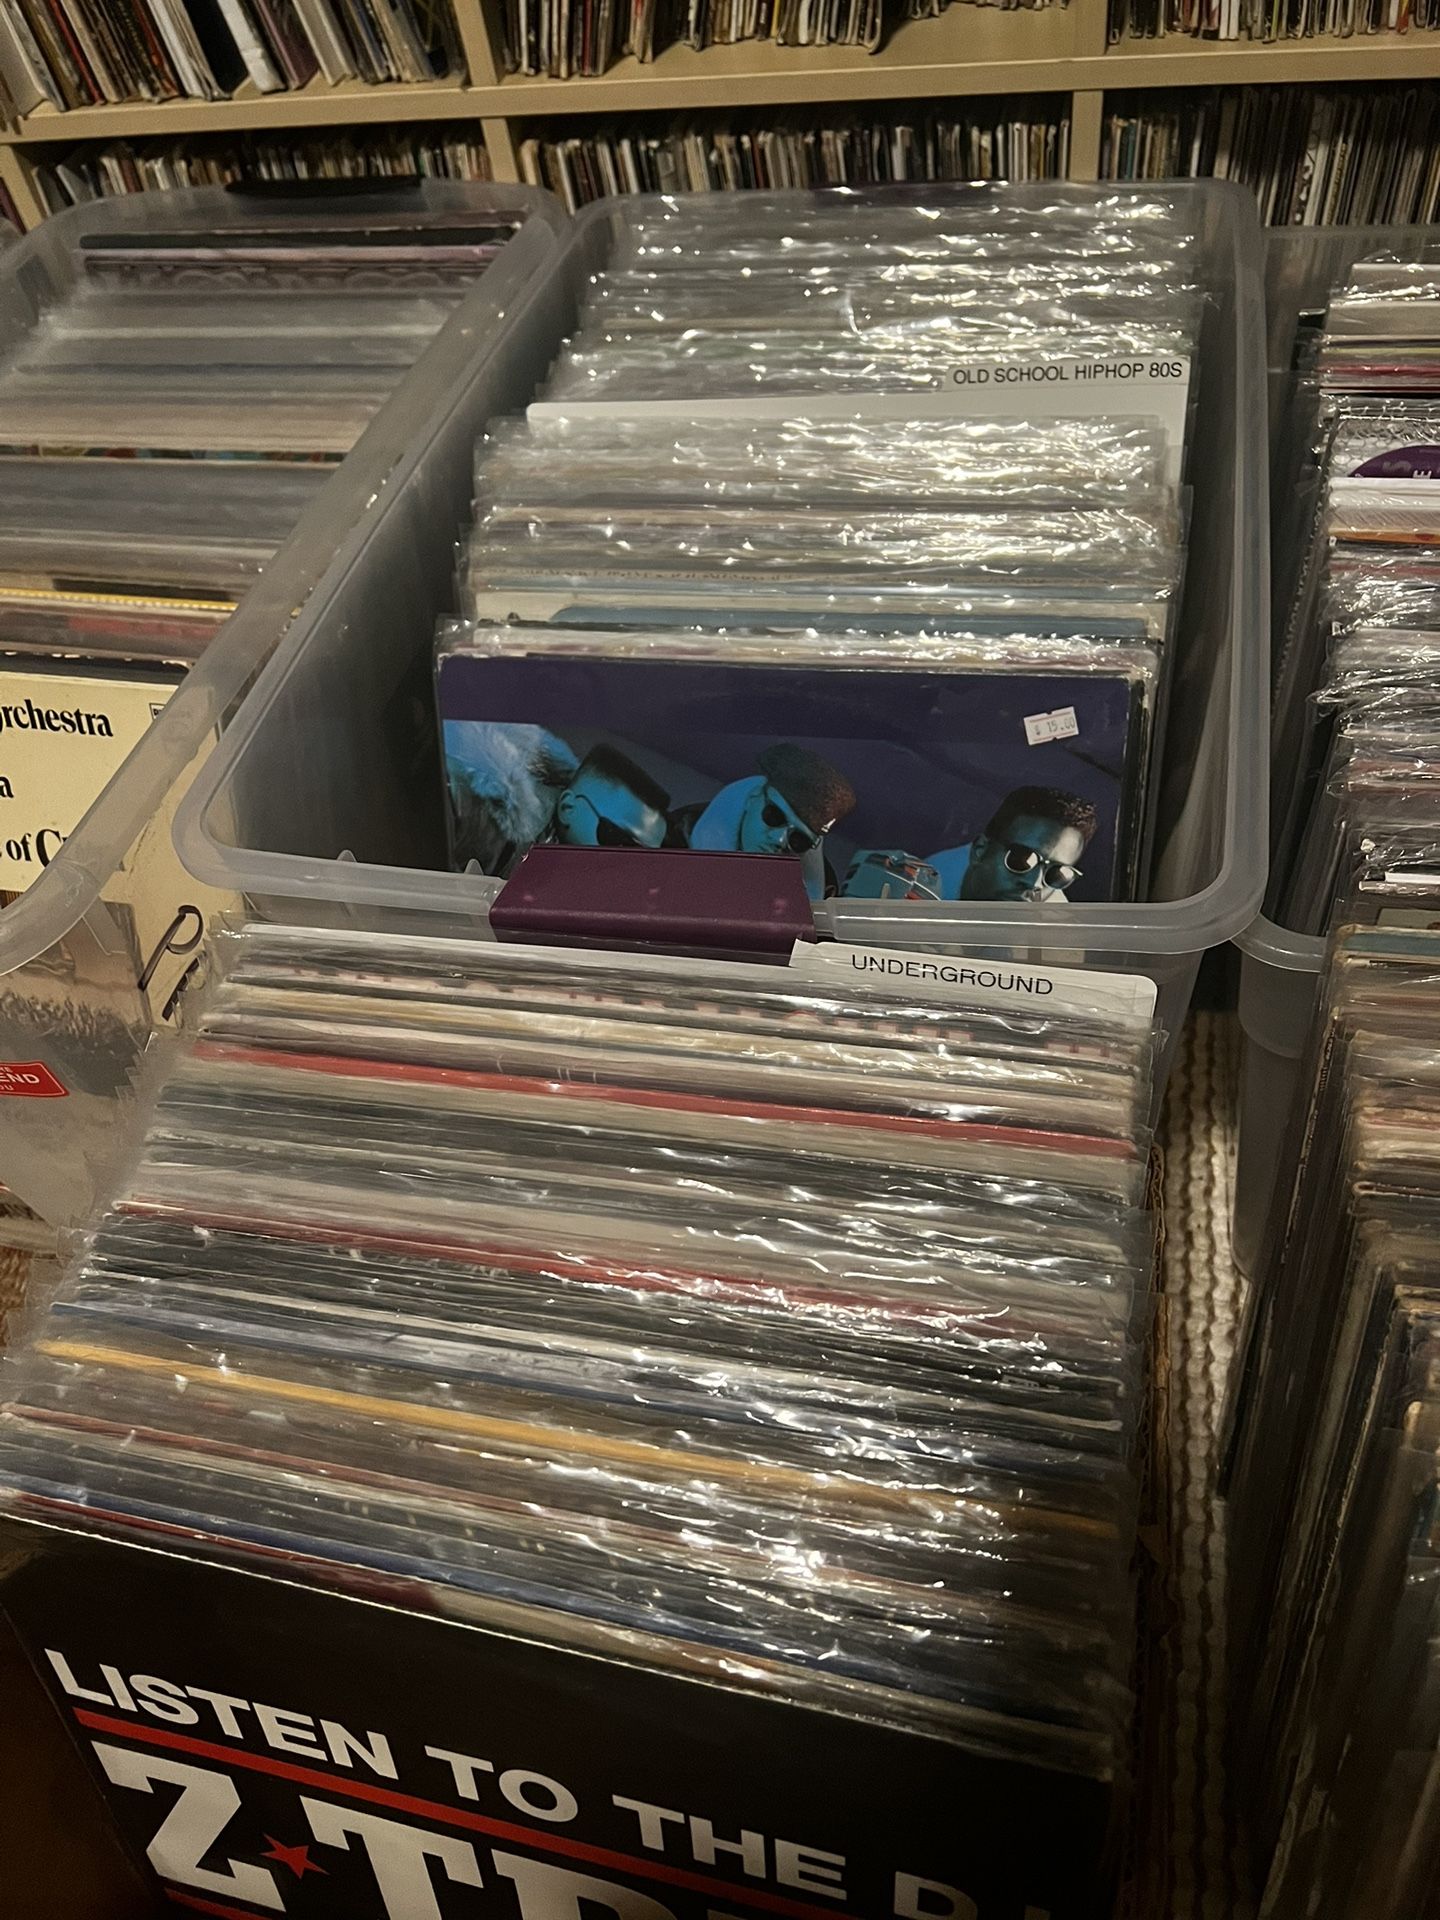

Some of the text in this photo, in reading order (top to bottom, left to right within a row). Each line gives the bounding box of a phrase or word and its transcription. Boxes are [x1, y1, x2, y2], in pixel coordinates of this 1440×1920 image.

[953, 362, 1183, 385] OLD SCHOOL HIPHOP 80S
[0, 698, 114, 737] rchestra
[6, 833, 32, 862] of
[851, 954, 1053, 996] UNDERGROUND
[44, 1647, 399, 1780] LISTEN
[424, 1744, 580, 1823] TO
[612, 1794, 847, 1902] THE
